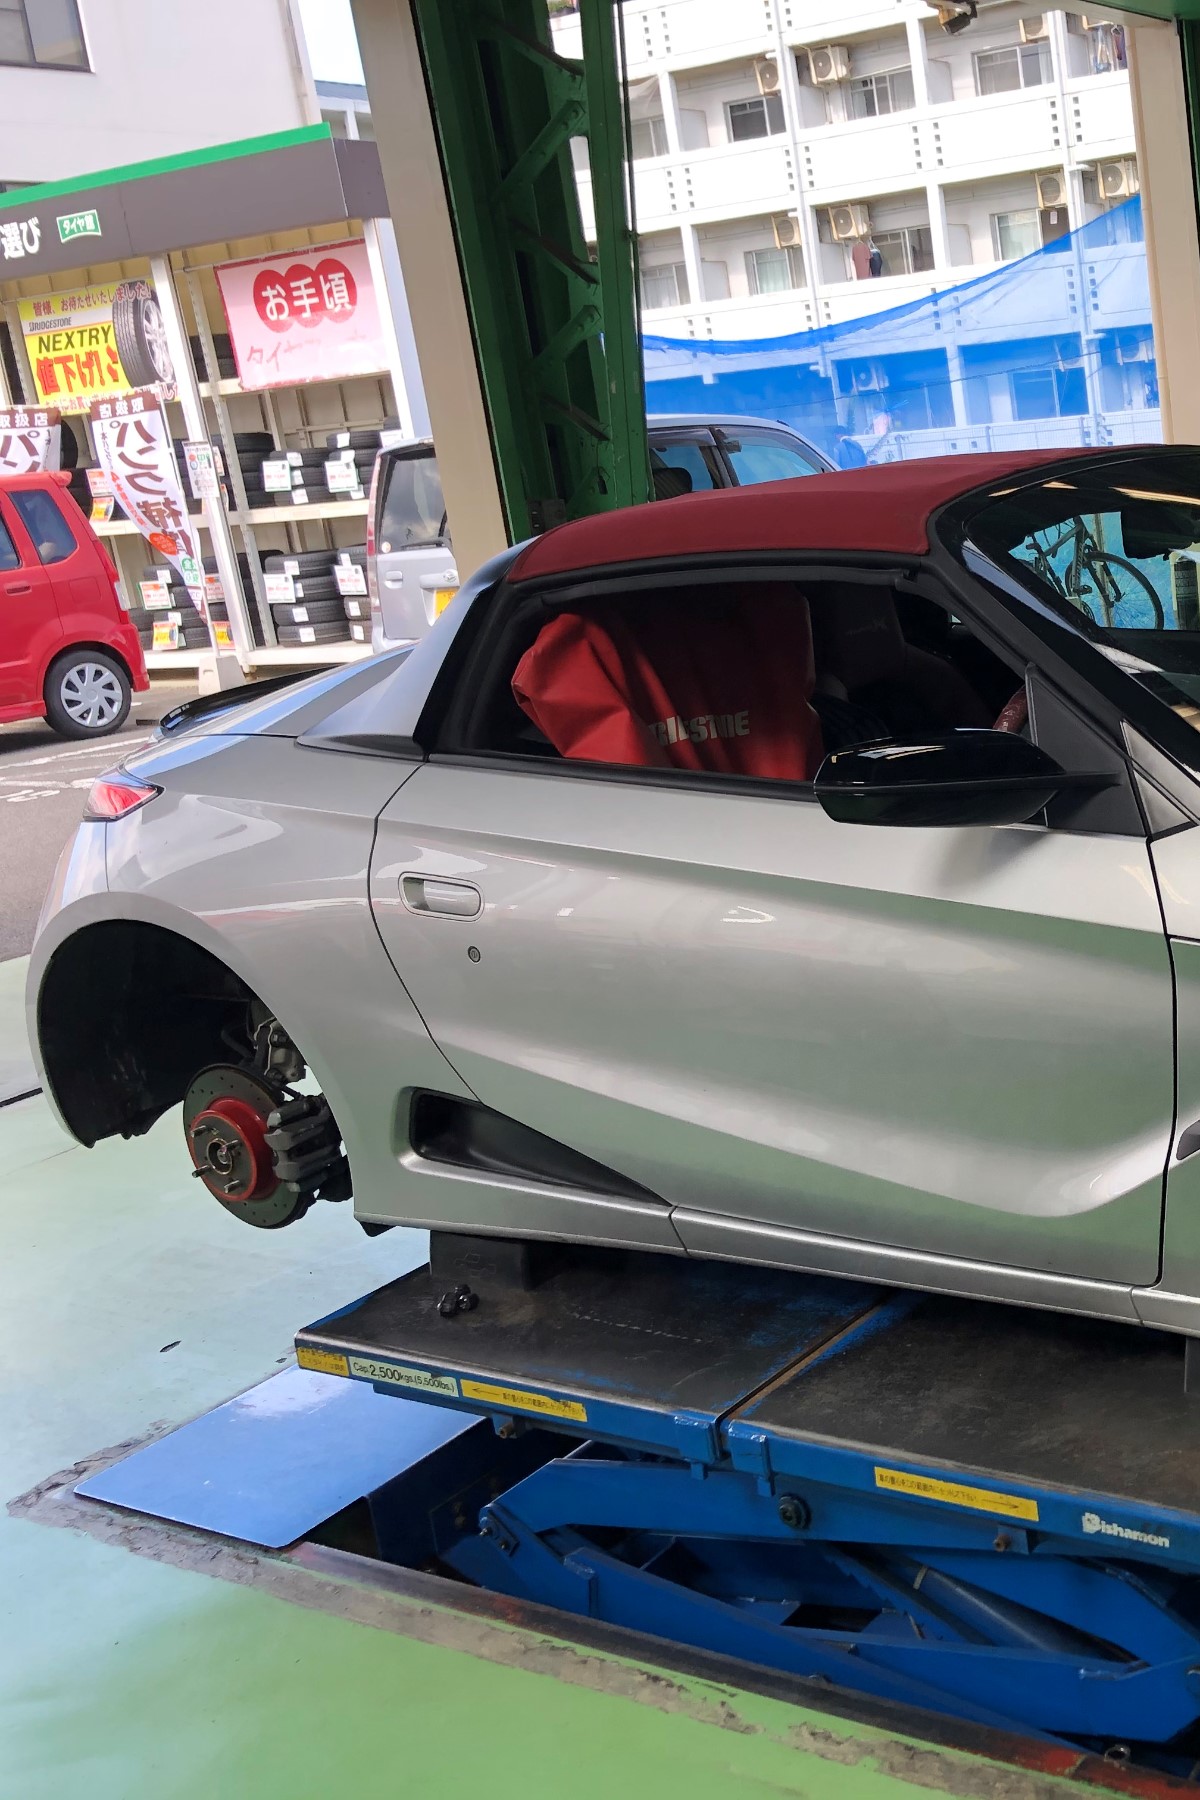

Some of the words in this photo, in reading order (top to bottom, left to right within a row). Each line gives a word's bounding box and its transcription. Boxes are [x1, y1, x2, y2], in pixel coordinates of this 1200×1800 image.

[62, 214, 96, 235] タイヤ館
[261, 272, 352, 322] お手頃
[28, 316, 72, 333] BRIDGESTONE
[38, 324, 113, 354] NEXTRY
[1081, 1512, 1170, 1548] Bishamon
